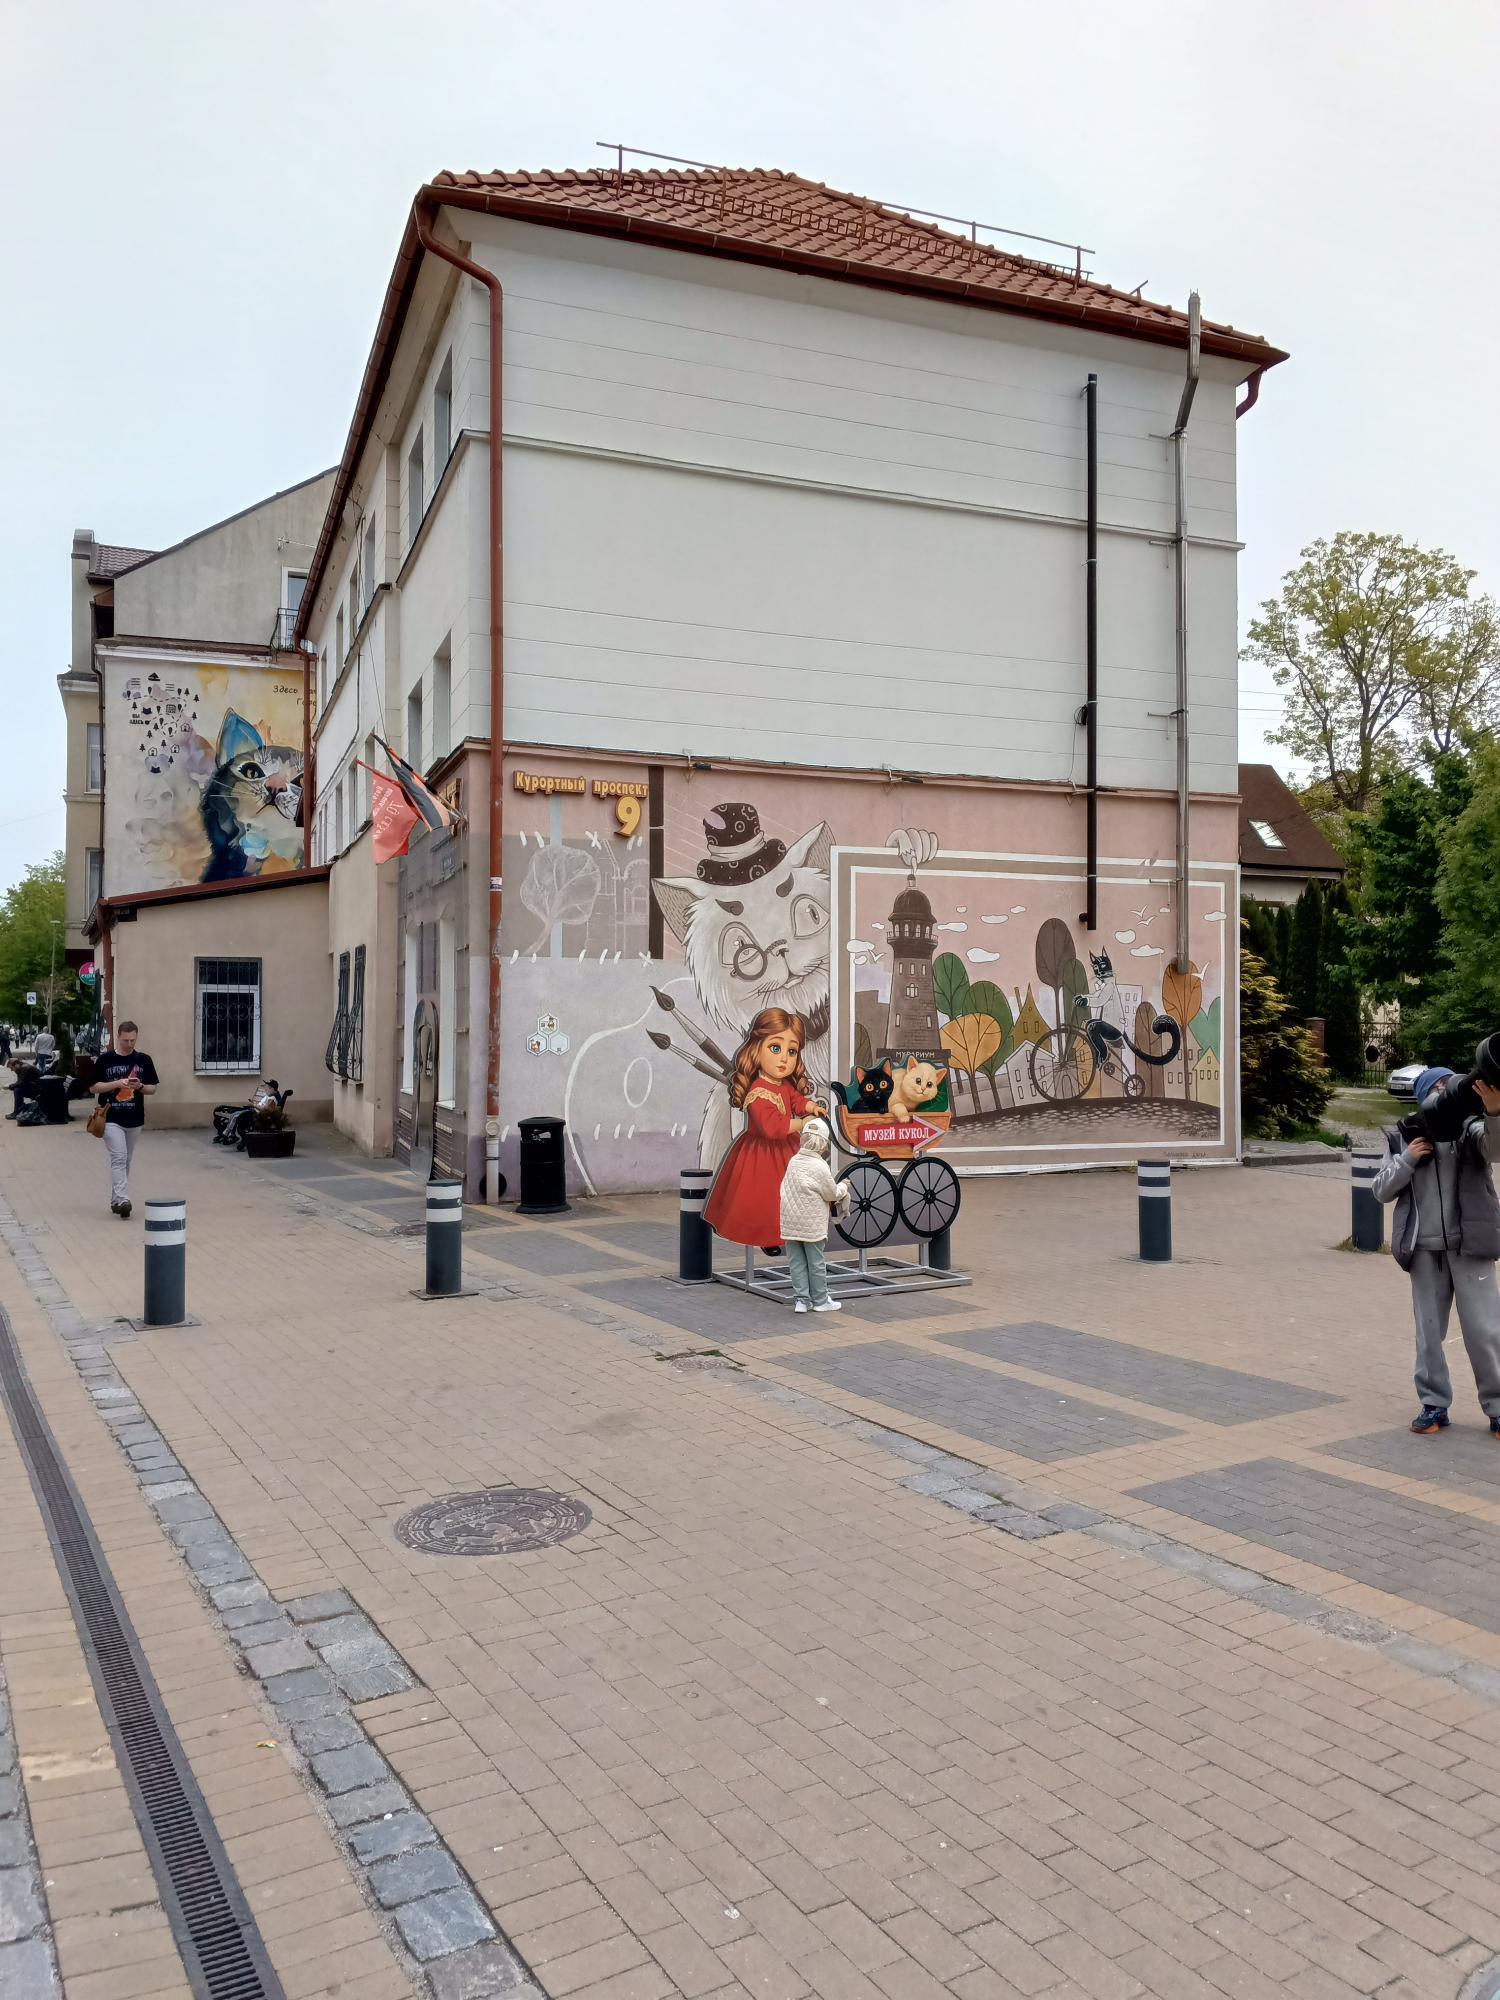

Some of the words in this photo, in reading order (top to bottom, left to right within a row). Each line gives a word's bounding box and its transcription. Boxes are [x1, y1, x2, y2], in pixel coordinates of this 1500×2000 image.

[515, 771, 585, 793] Курортный
[593, 780, 648, 797] проспект
[615, 795, 641, 836] 9
[864, 1126, 896, 1141] МУЗЕЙ
[899, 1127, 930, 1139] КУКОЛ
